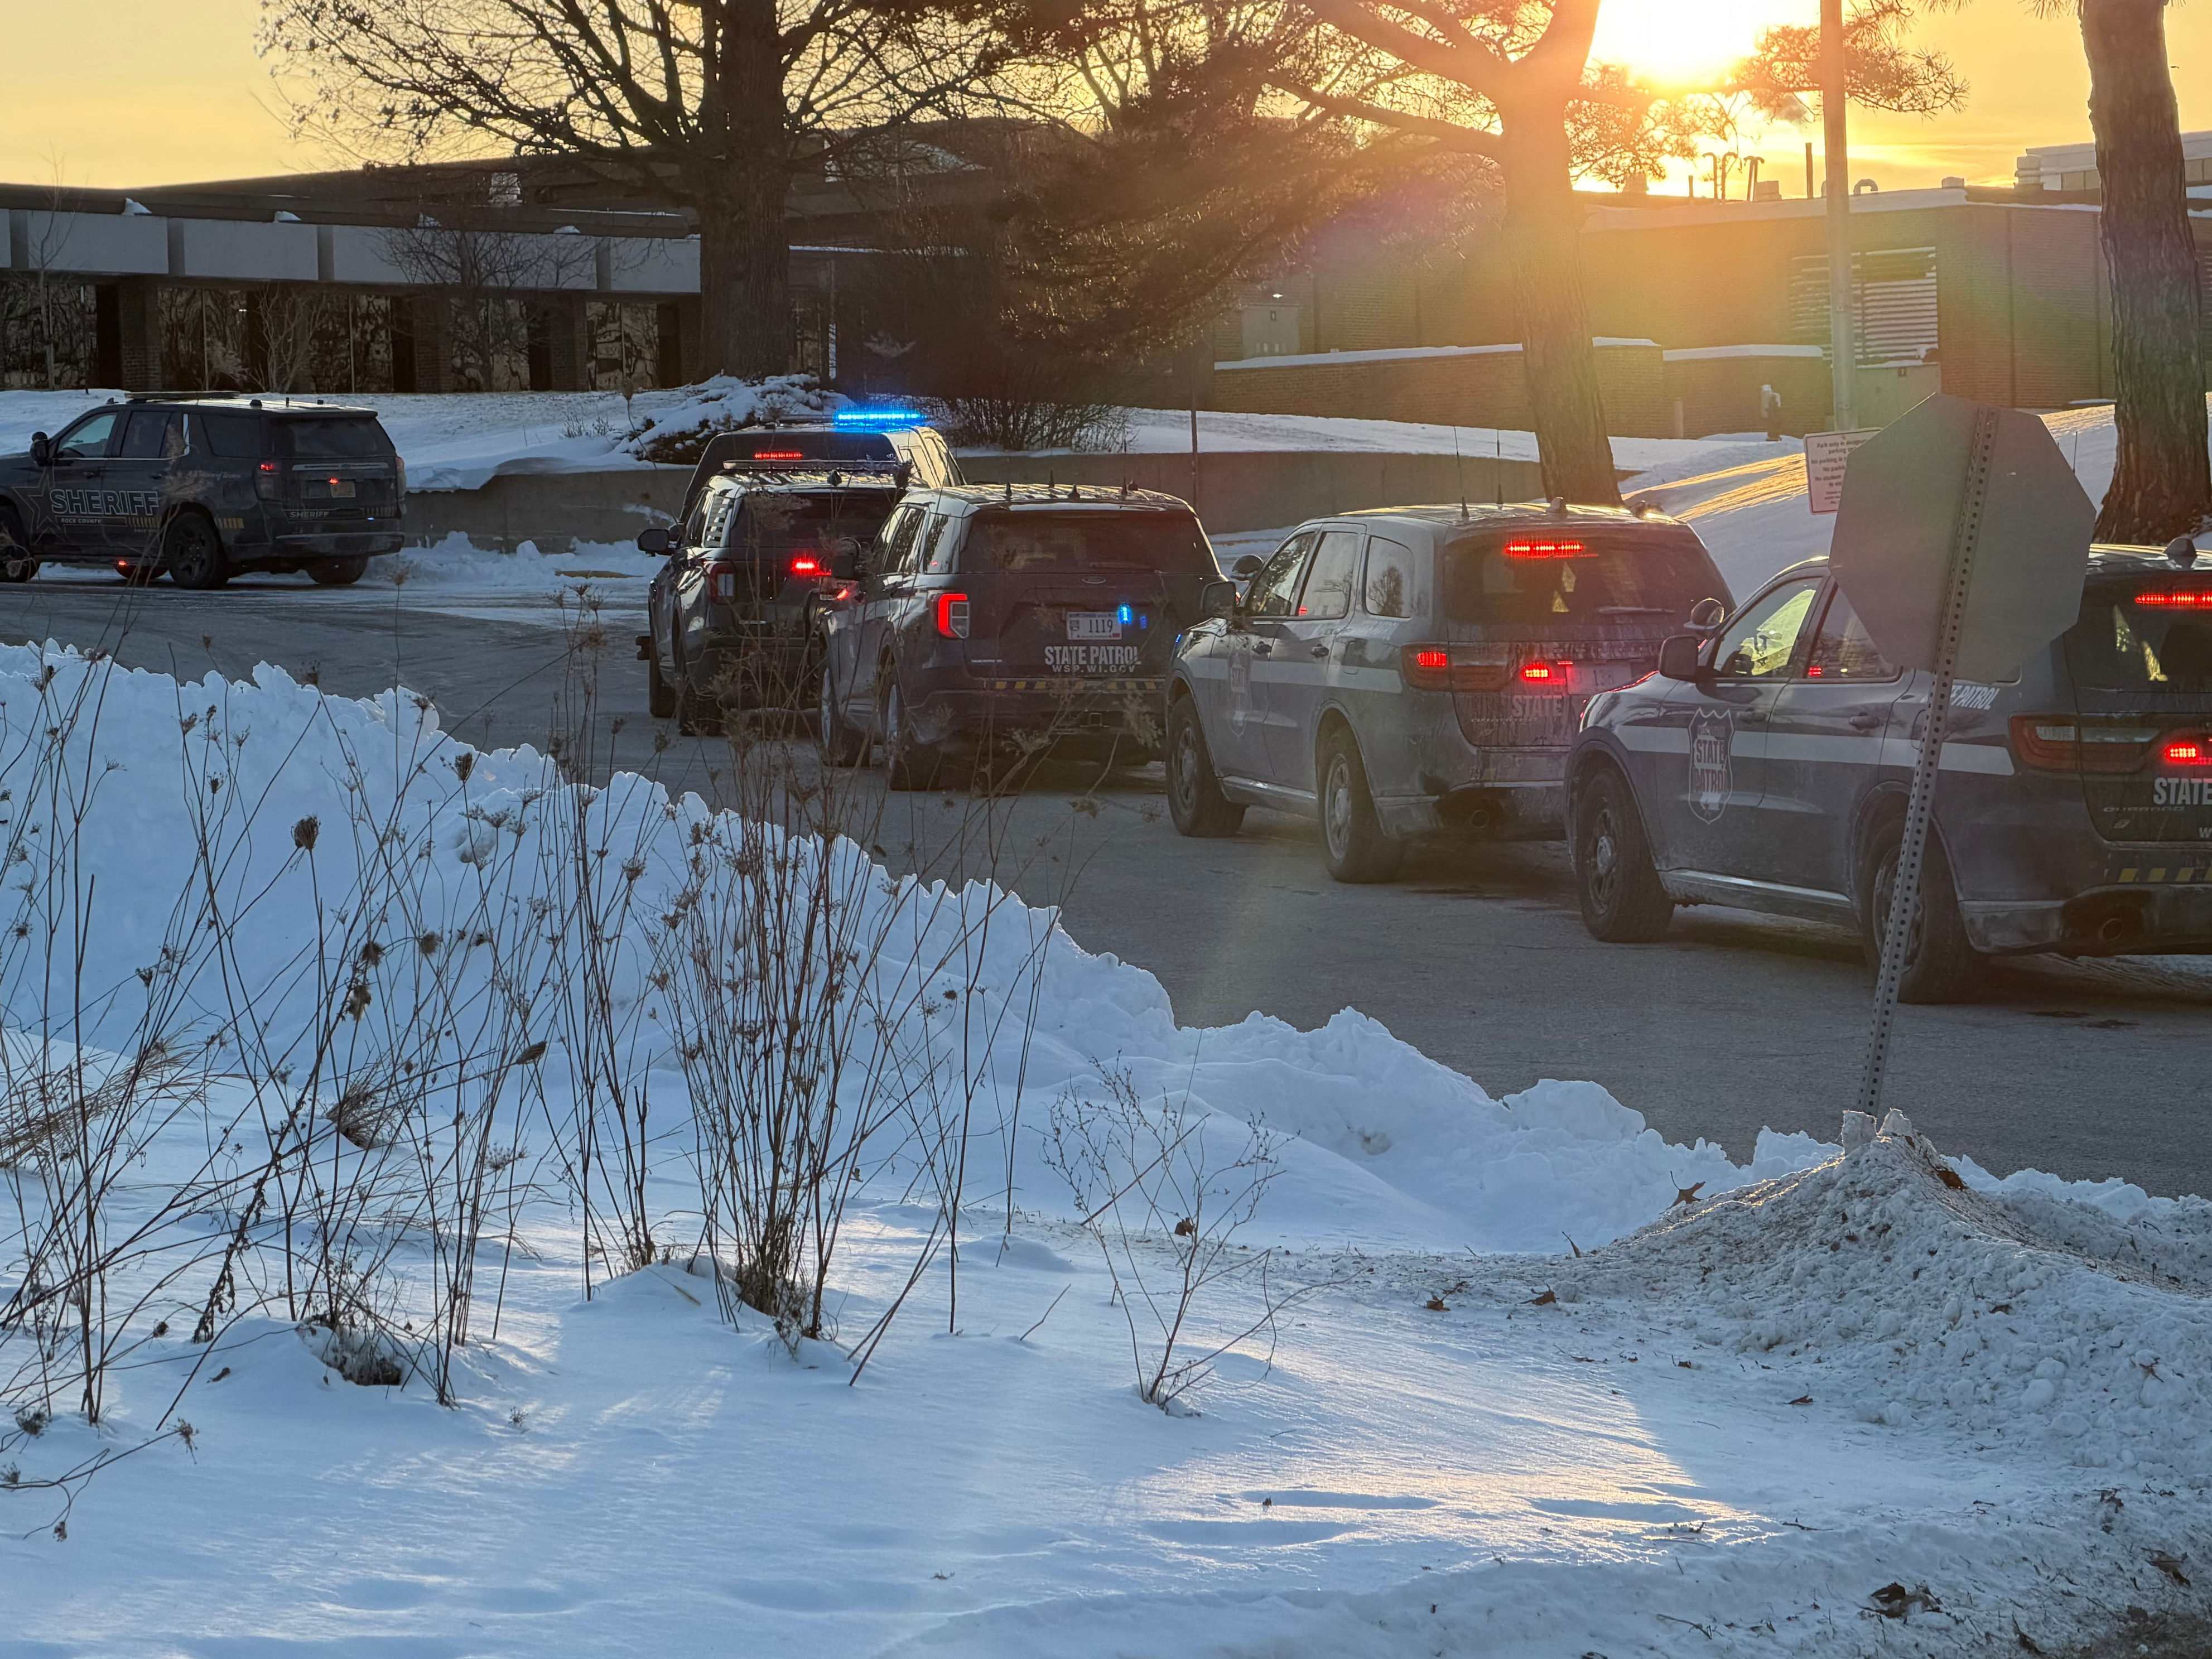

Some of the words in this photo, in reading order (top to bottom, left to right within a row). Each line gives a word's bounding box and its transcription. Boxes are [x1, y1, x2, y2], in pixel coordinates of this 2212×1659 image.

[50, 489, 159, 516] SHERIFF
[1088, 619, 1113, 633] 1119
[1044, 646, 1087, 665] STATE
[1090, 646, 1141, 665] PATROL
[1512, 695, 1562, 717] STATE
[1951, 685, 2000, 710] PATROL
[1696, 740, 1725, 764] STATE
[1693, 768, 1727, 793] PATROL
[2153, 777, 2212, 805] STATE
